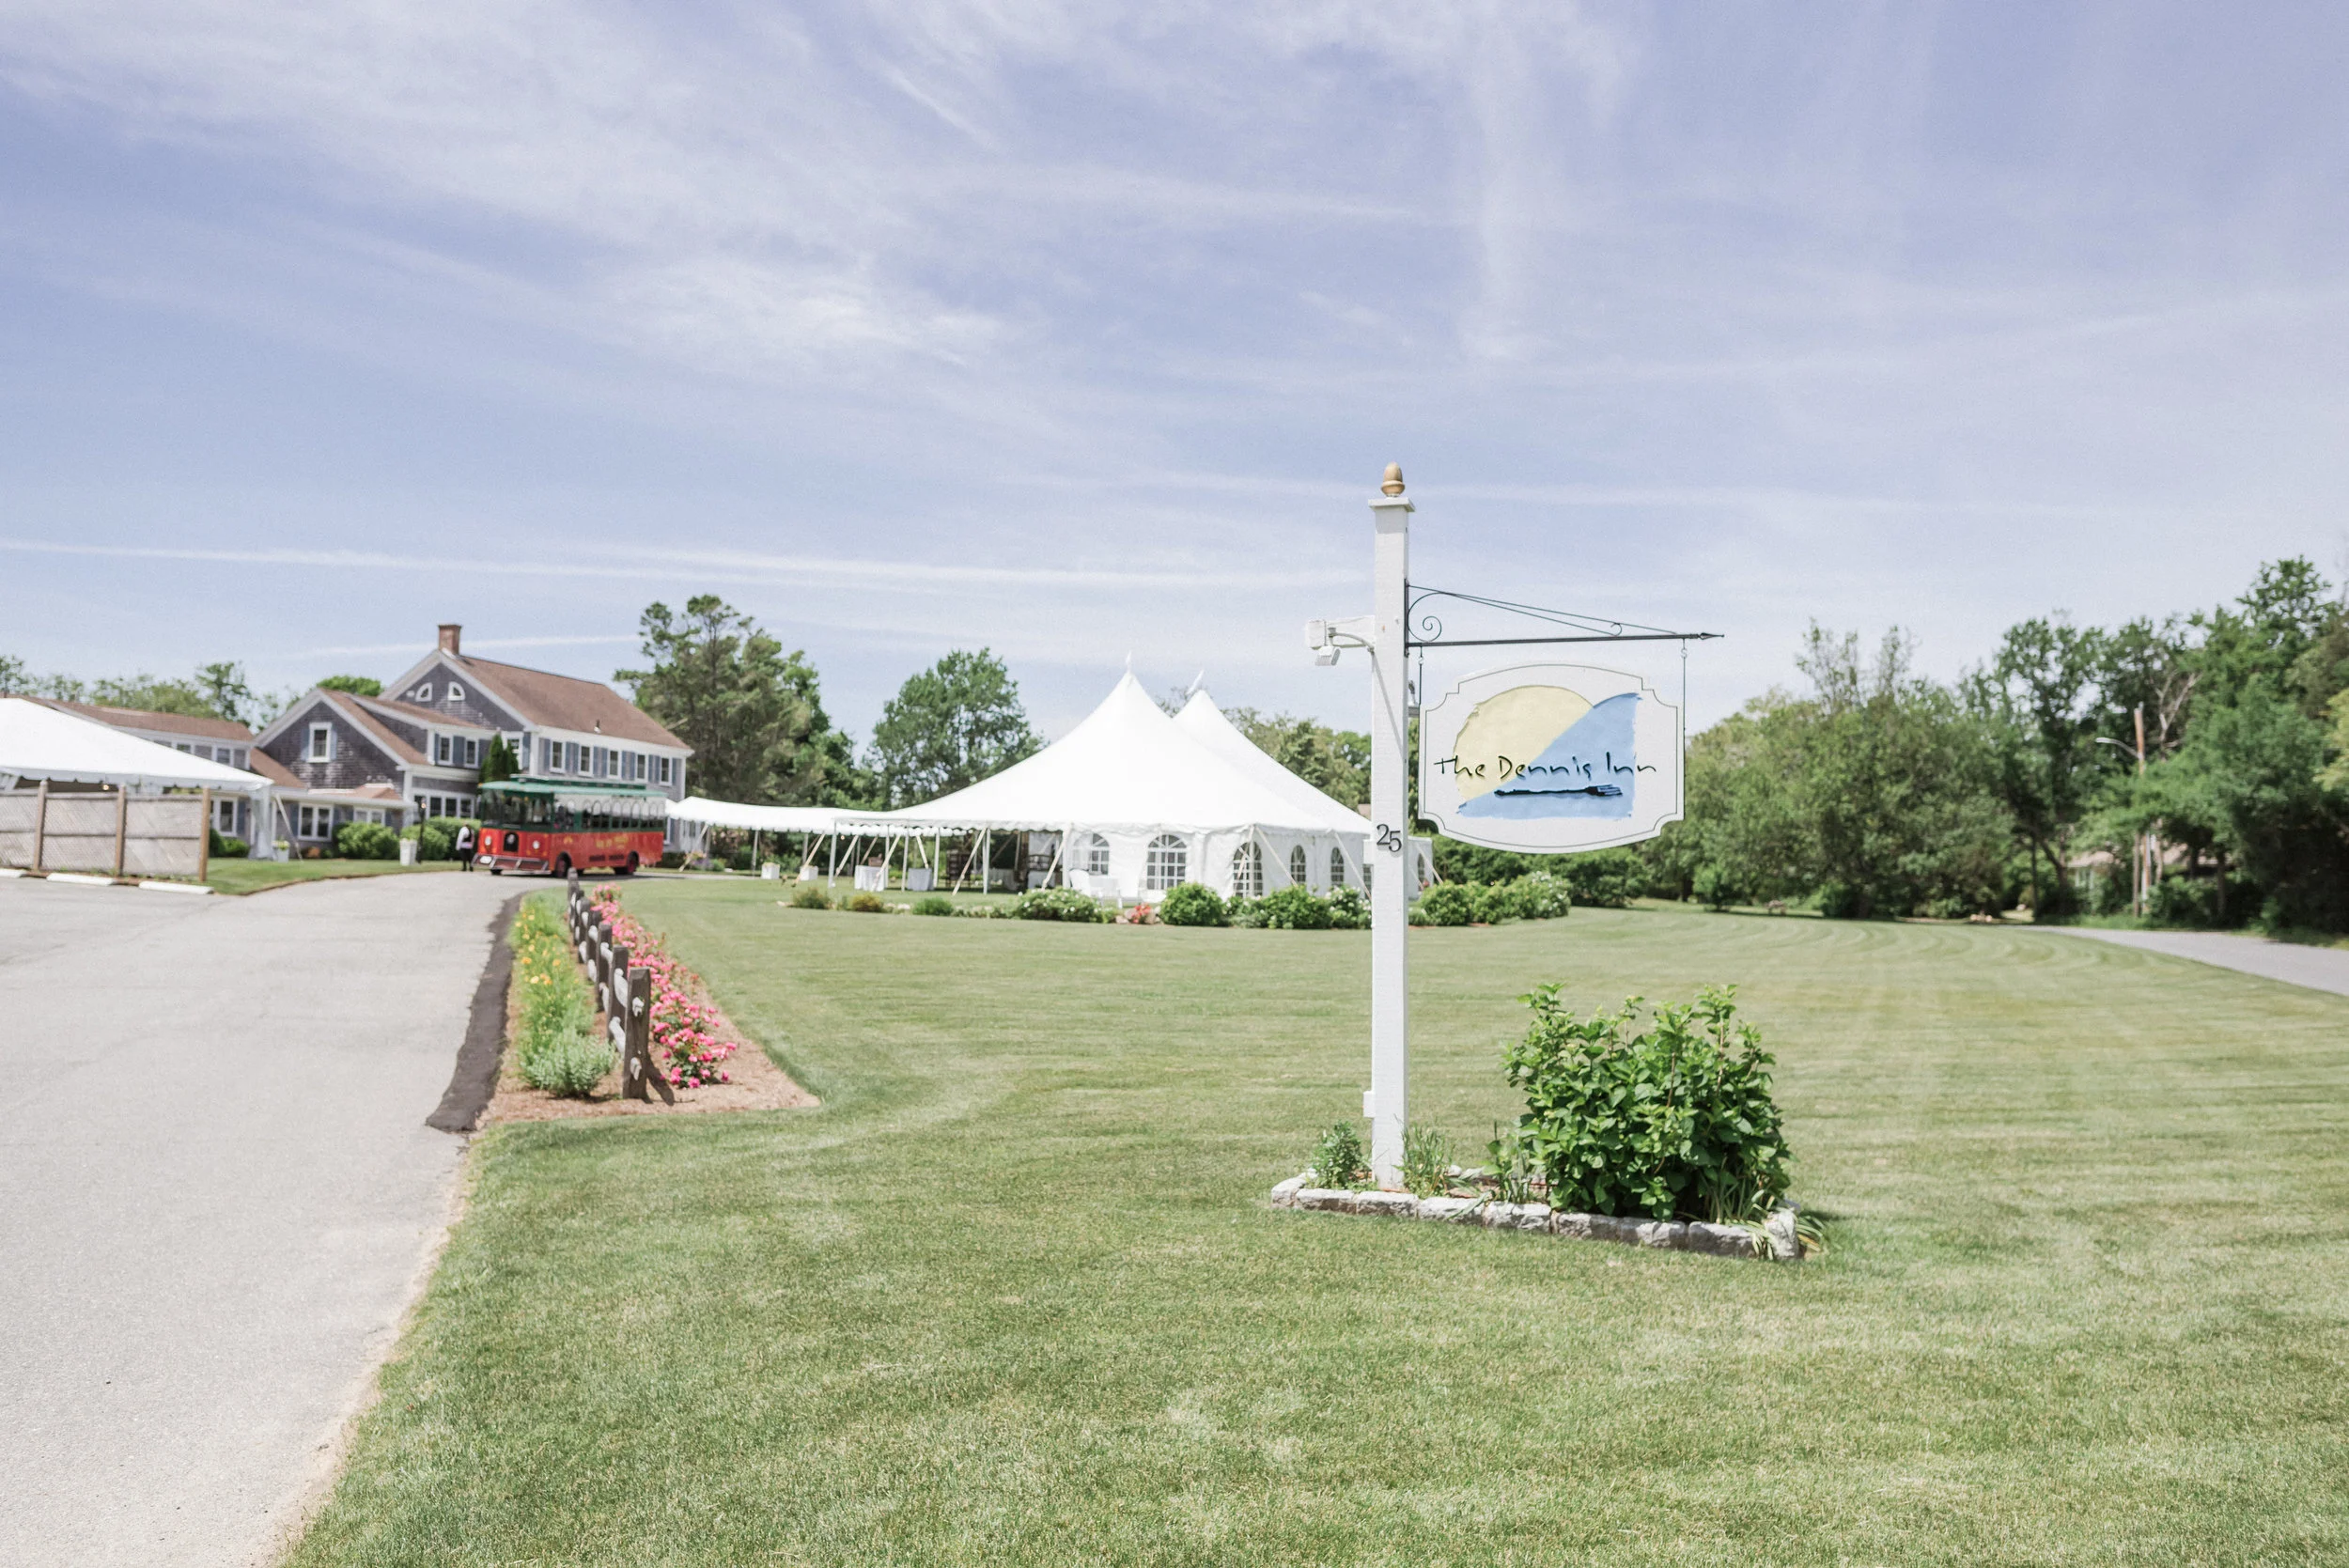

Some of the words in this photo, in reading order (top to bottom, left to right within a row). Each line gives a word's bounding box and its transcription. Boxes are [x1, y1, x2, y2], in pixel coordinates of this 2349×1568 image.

[1498, 754, 1592, 781] Dennis
[1605, 752, 1657, 776] Inn
[1377, 824, 1402, 852] 25
